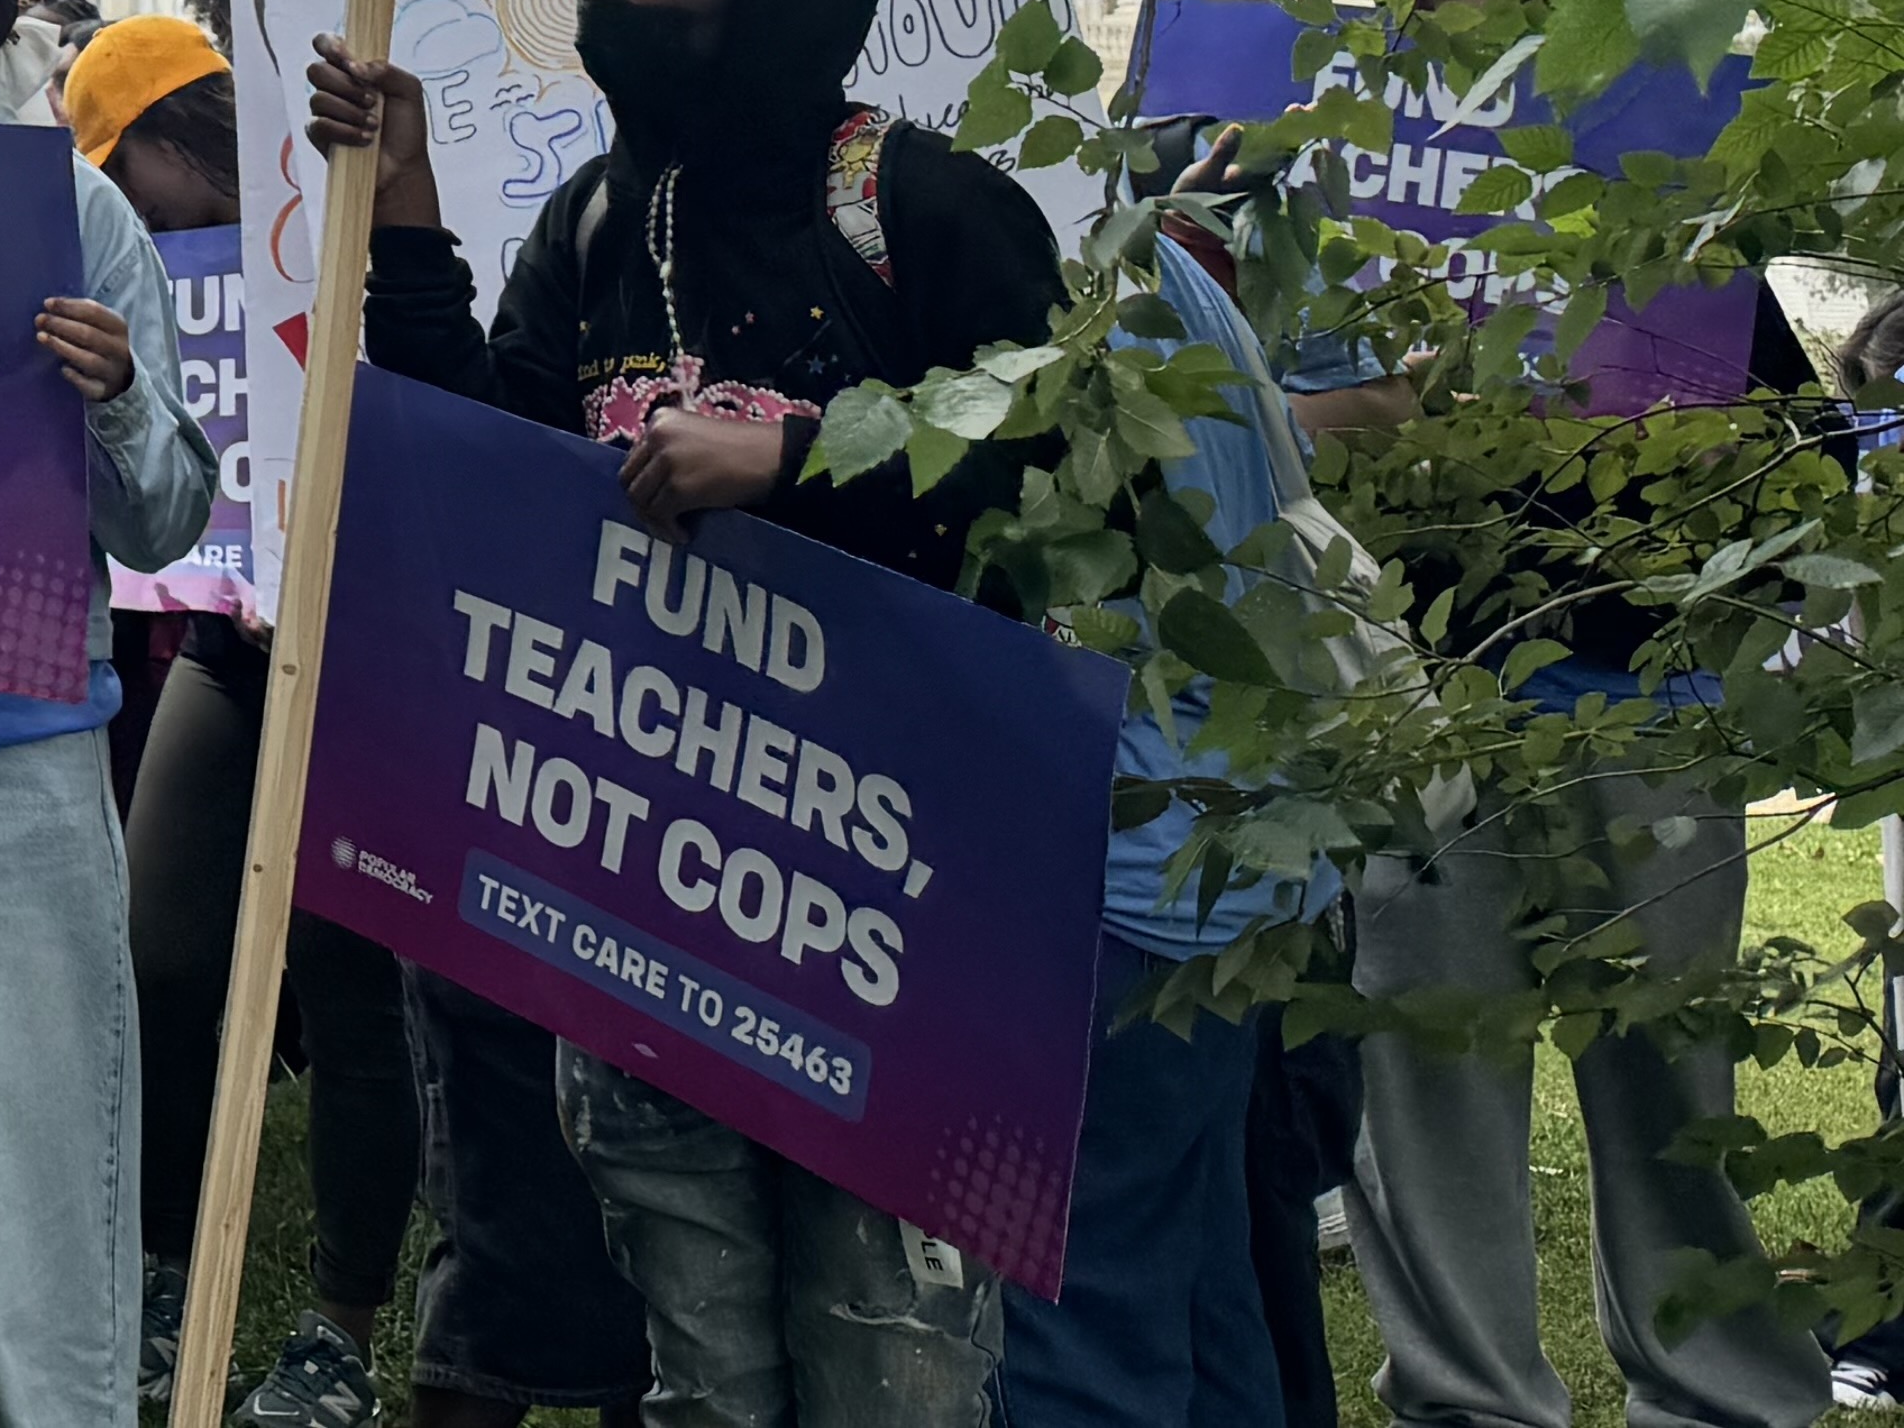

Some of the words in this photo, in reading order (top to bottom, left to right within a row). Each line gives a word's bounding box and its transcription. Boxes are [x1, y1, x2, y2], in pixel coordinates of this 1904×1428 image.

[189, 545, 243, 568] ARE
[592, 519, 825, 693] FUND
[453, 589, 934, 899] TEACHERS,
[465, 722, 650, 875] NOT
[658, 818, 904, 1007] COPS
[478, 873, 567, 944] TEXT
[572, 924, 669, 1000] CARE
[678, 974, 724, 1027] TO
[730, 1005, 853, 1095] 25463
